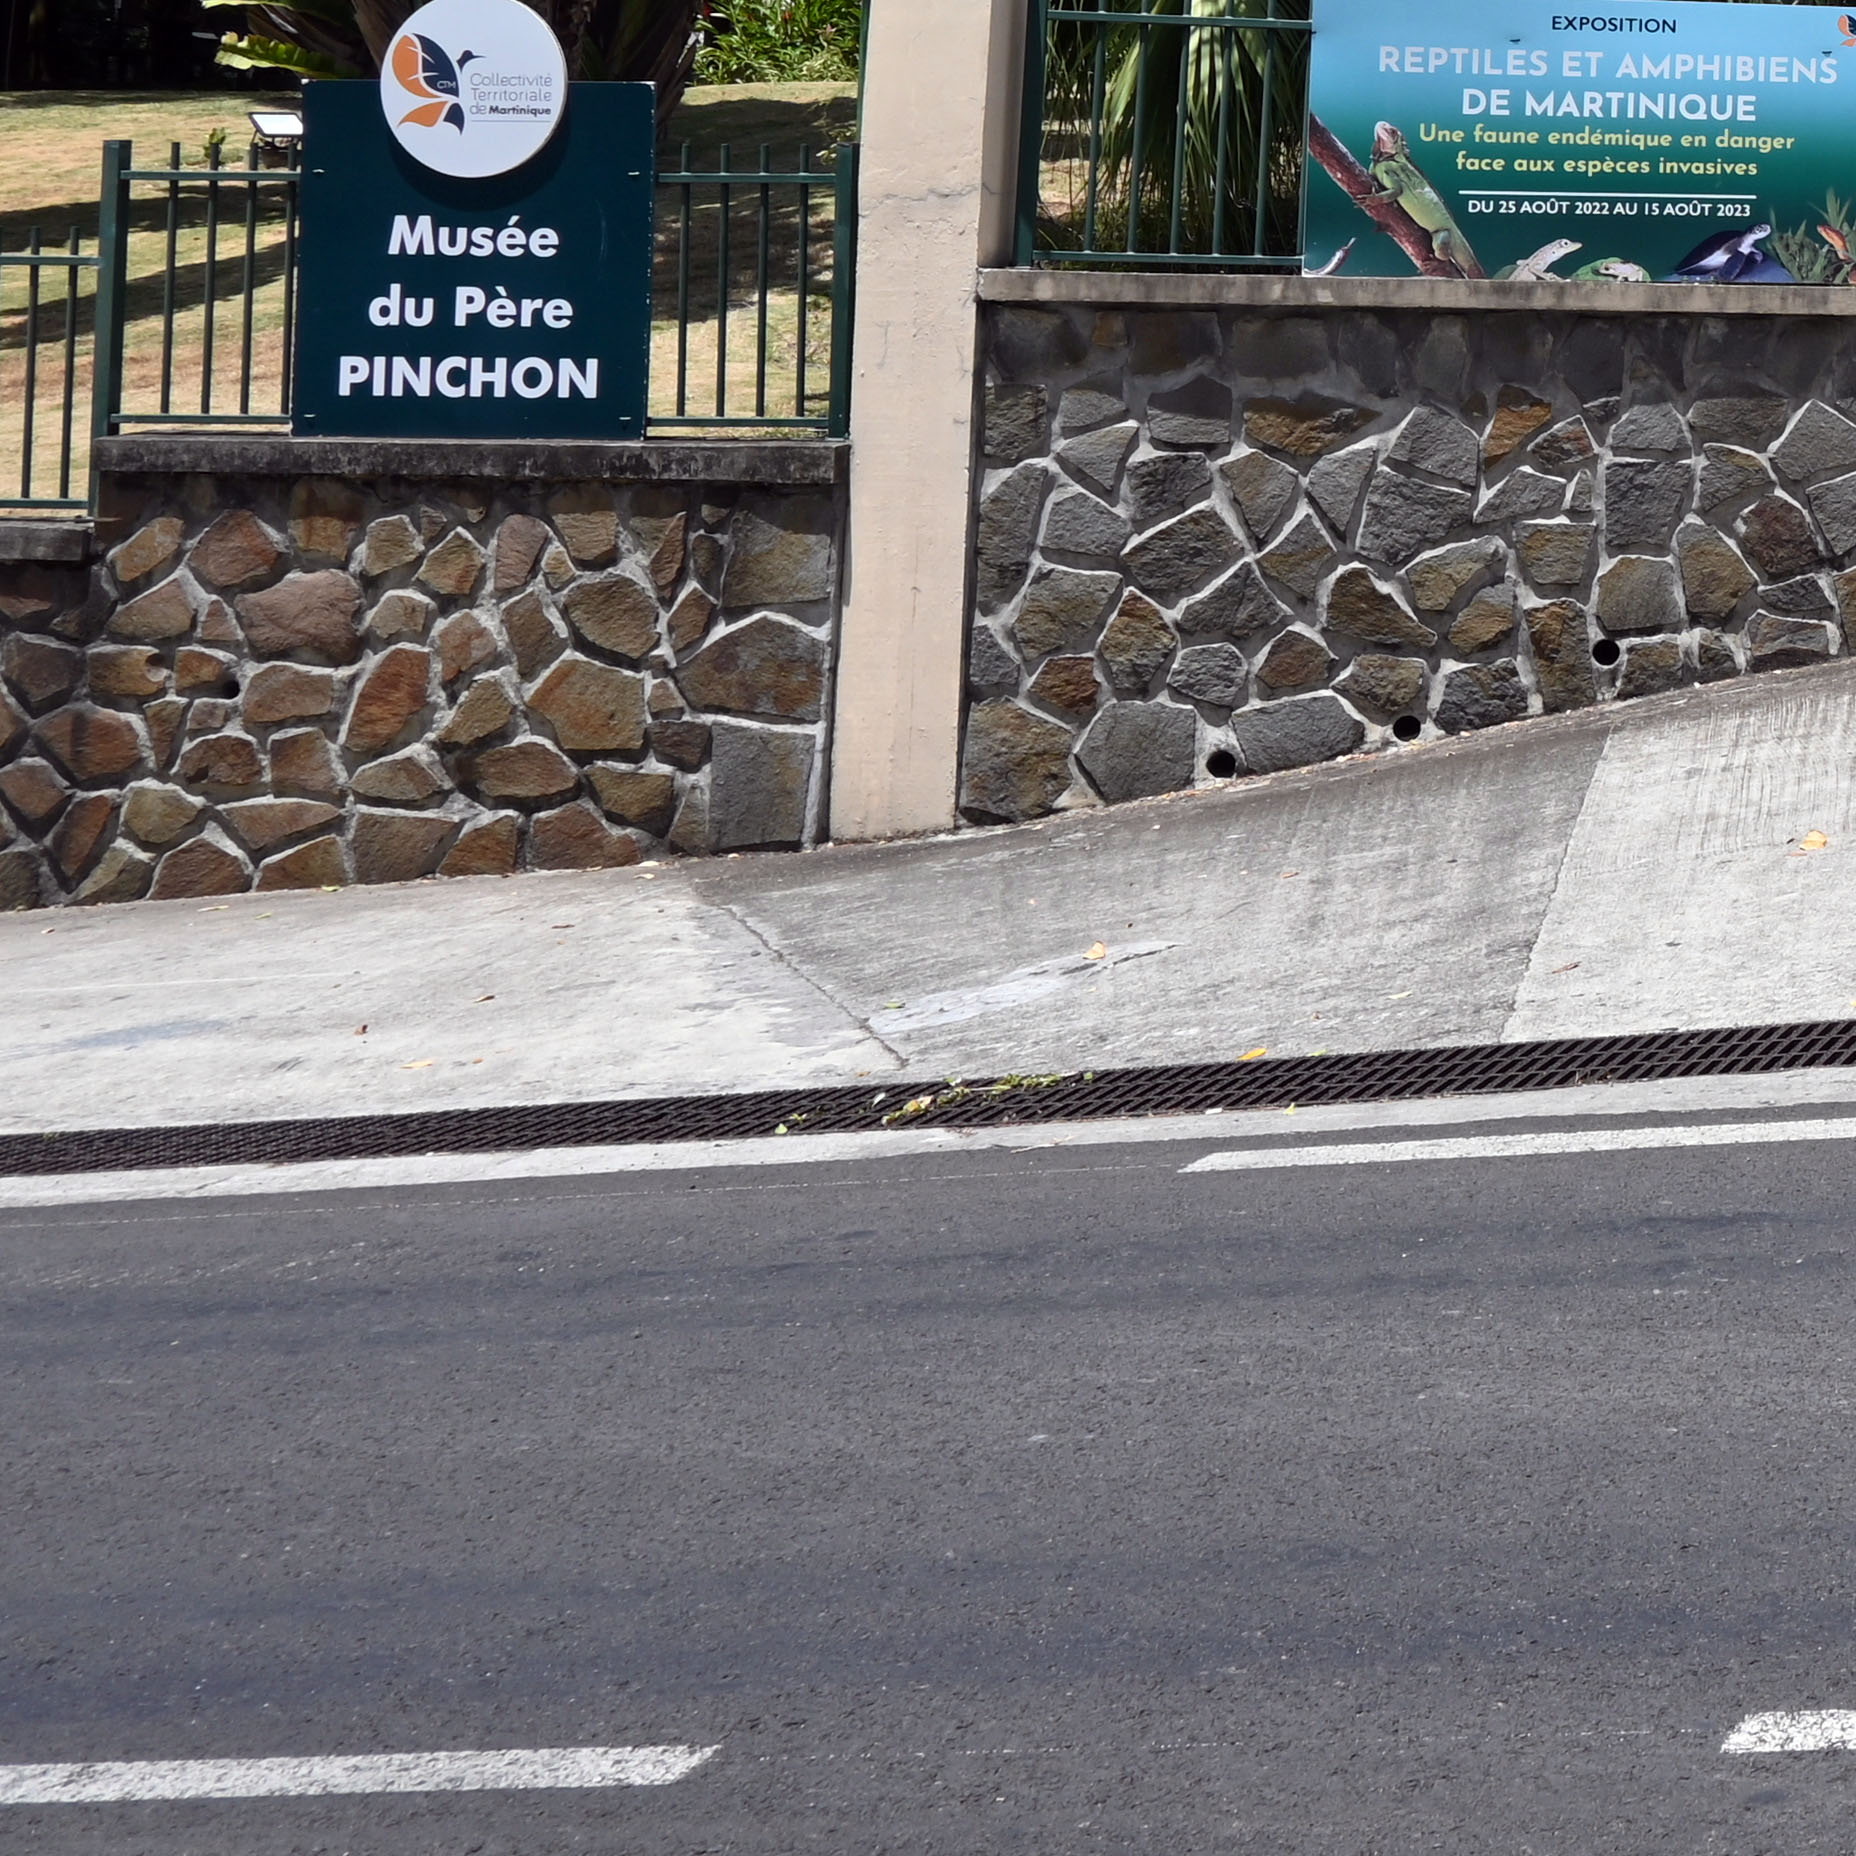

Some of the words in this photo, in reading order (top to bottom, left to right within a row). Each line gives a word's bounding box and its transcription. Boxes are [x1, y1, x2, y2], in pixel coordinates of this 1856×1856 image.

[1552, 16, 1676, 34] EXPOSITION
[1379, 47, 1548, 76] REPTILES
[1562, 52, 1603, 77] ET
[1616, 53, 1839, 84] AMPHIBIENS
[437, 80, 456, 89] CTM
[470, 73, 552, 89] Collectivité
[471, 88, 552, 102] Territoriale
[1462, 89, 1510, 116] DE
[1526, 91, 1757, 122] MARTINIQUE
[470, 103, 486, 116] de
[489, 105, 551, 118] Martinique
[1420, 123, 1465, 143] Une
[1474, 125, 1539, 144] faune
[1548, 126, 1673, 151] endémique
[1681, 132, 1708, 147] en
[1715, 129, 1795, 153] danger
[1456, 151, 1506, 172] face
[1514, 156, 1556, 172] aux
[1563, 152, 1651, 177] espèces
[1658, 156, 1758, 176] invasives
[1468, 200, 1493, 213] DU
[1498, 200, 1517, 214] 25
[1521, 197, 1569, 215] AOÛT
[1575, 201, 1609, 215] 2022
[1613, 202, 1638, 215] AU
[1645, 202, 1661, 216] 15
[1664, 199, 1712, 217] AOÛT
[1717, 203, 1751, 217] 2023
[387, 215, 559, 257] Musée
[368, 284, 434, 327] du
[454, 286, 573, 328] Père
[338, 355, 599, 399] PINCHON
